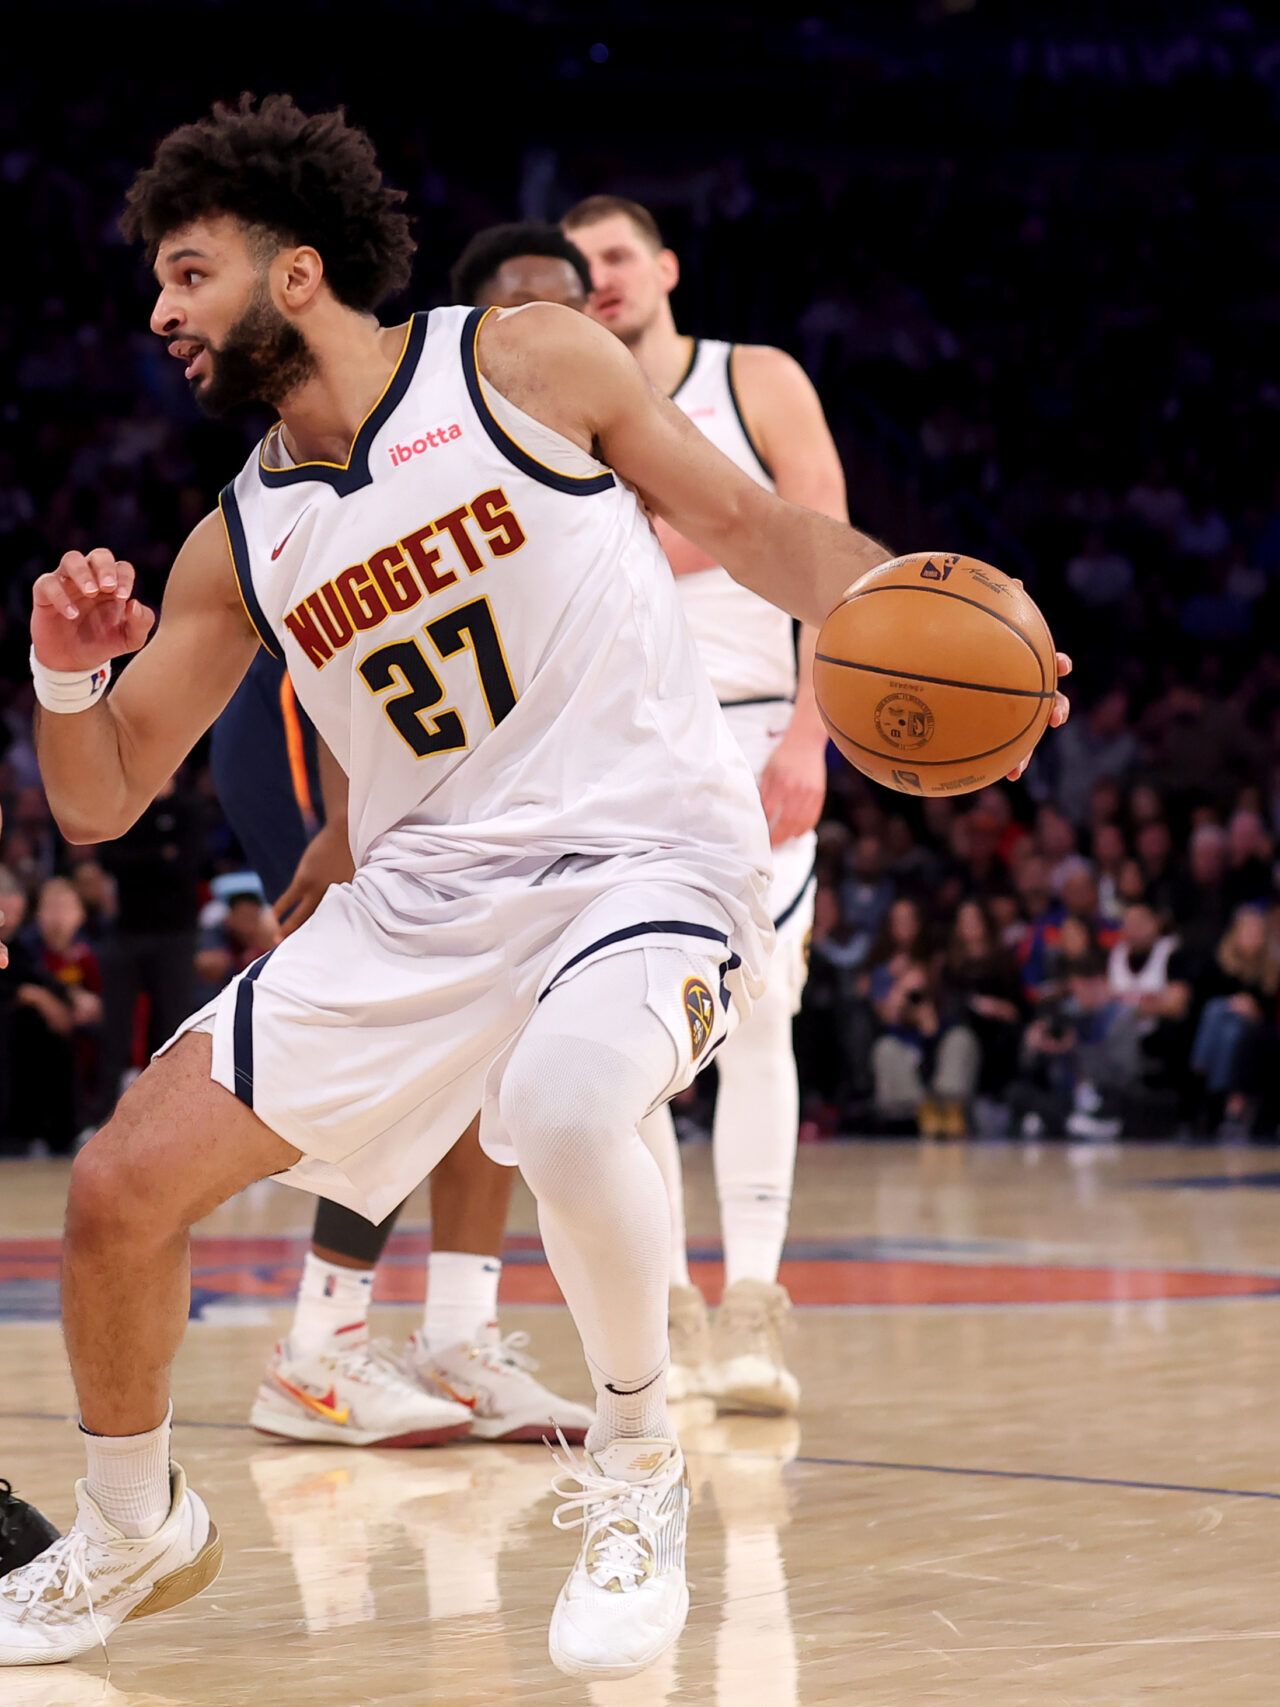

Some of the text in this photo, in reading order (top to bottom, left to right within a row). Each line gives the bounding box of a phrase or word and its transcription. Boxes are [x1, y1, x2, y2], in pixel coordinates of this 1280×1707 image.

[388, 423, 463, 466] ibotta
[283, 487, 527, 671] NUGGETS
[356, 594, 520, 760] 27
